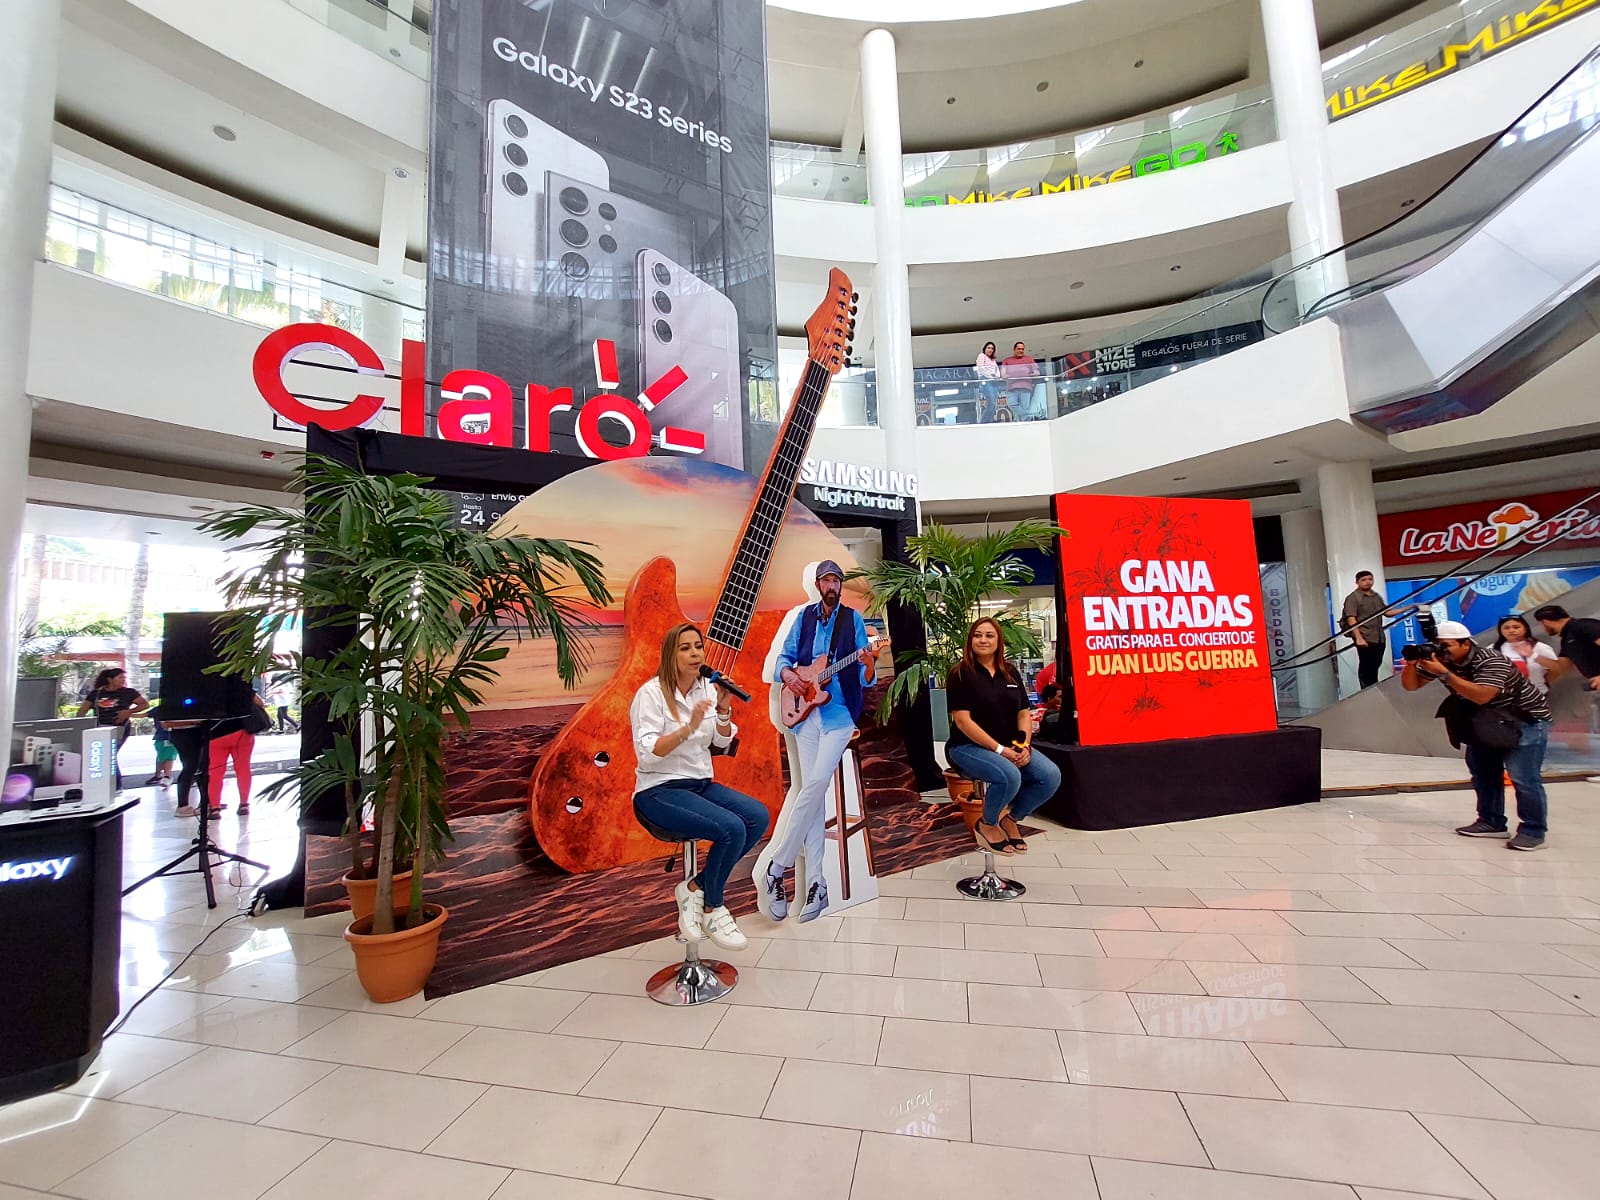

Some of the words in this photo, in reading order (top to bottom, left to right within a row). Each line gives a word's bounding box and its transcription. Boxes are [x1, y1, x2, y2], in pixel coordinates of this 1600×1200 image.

[492, 37, 604, 103] Galaxy
[608, 85, 653, 119] S23
[657, 105, 733, 153] Series
[1136, 142, 1207, 177] GO
[1095, 344, 1135, 363] NIZE
[1141, 344, 1180, 358] REGALOS
[1182, 340, 1209, 351] FUERA
[1211, 337, 1223, 346] DE
[1225, 333, 1248, 343] SERIE
[1096, 358, 1136, 373] STORE
[253, 322, 705, 460] Claro
[800, 458, 918, 495] SAMSUNG
[814, 486, 853, 508] Night
[854, 491, 905, 512] Portrait
[460, 509, 486, 526] 24
[1120, 559, 1215, 594] GANA
[1083, 594, 1254, 631] ENTRADAS
[1086, 634, 1130, 650] GRATIS
[1131, 634, 1162, 647] PARA
[1163, 633, 1177, 646] EL
[1179, 632, 1240, 646] CONCIERTO
[1240, 631, 1256, 644] DE
[1086, 652, 1140, 677] JUAN
[1142, 650, 1184, 674] LUIS
[1185, 648, 1259, 671] GUERRA
[0, 856, 73, 882] laxy
